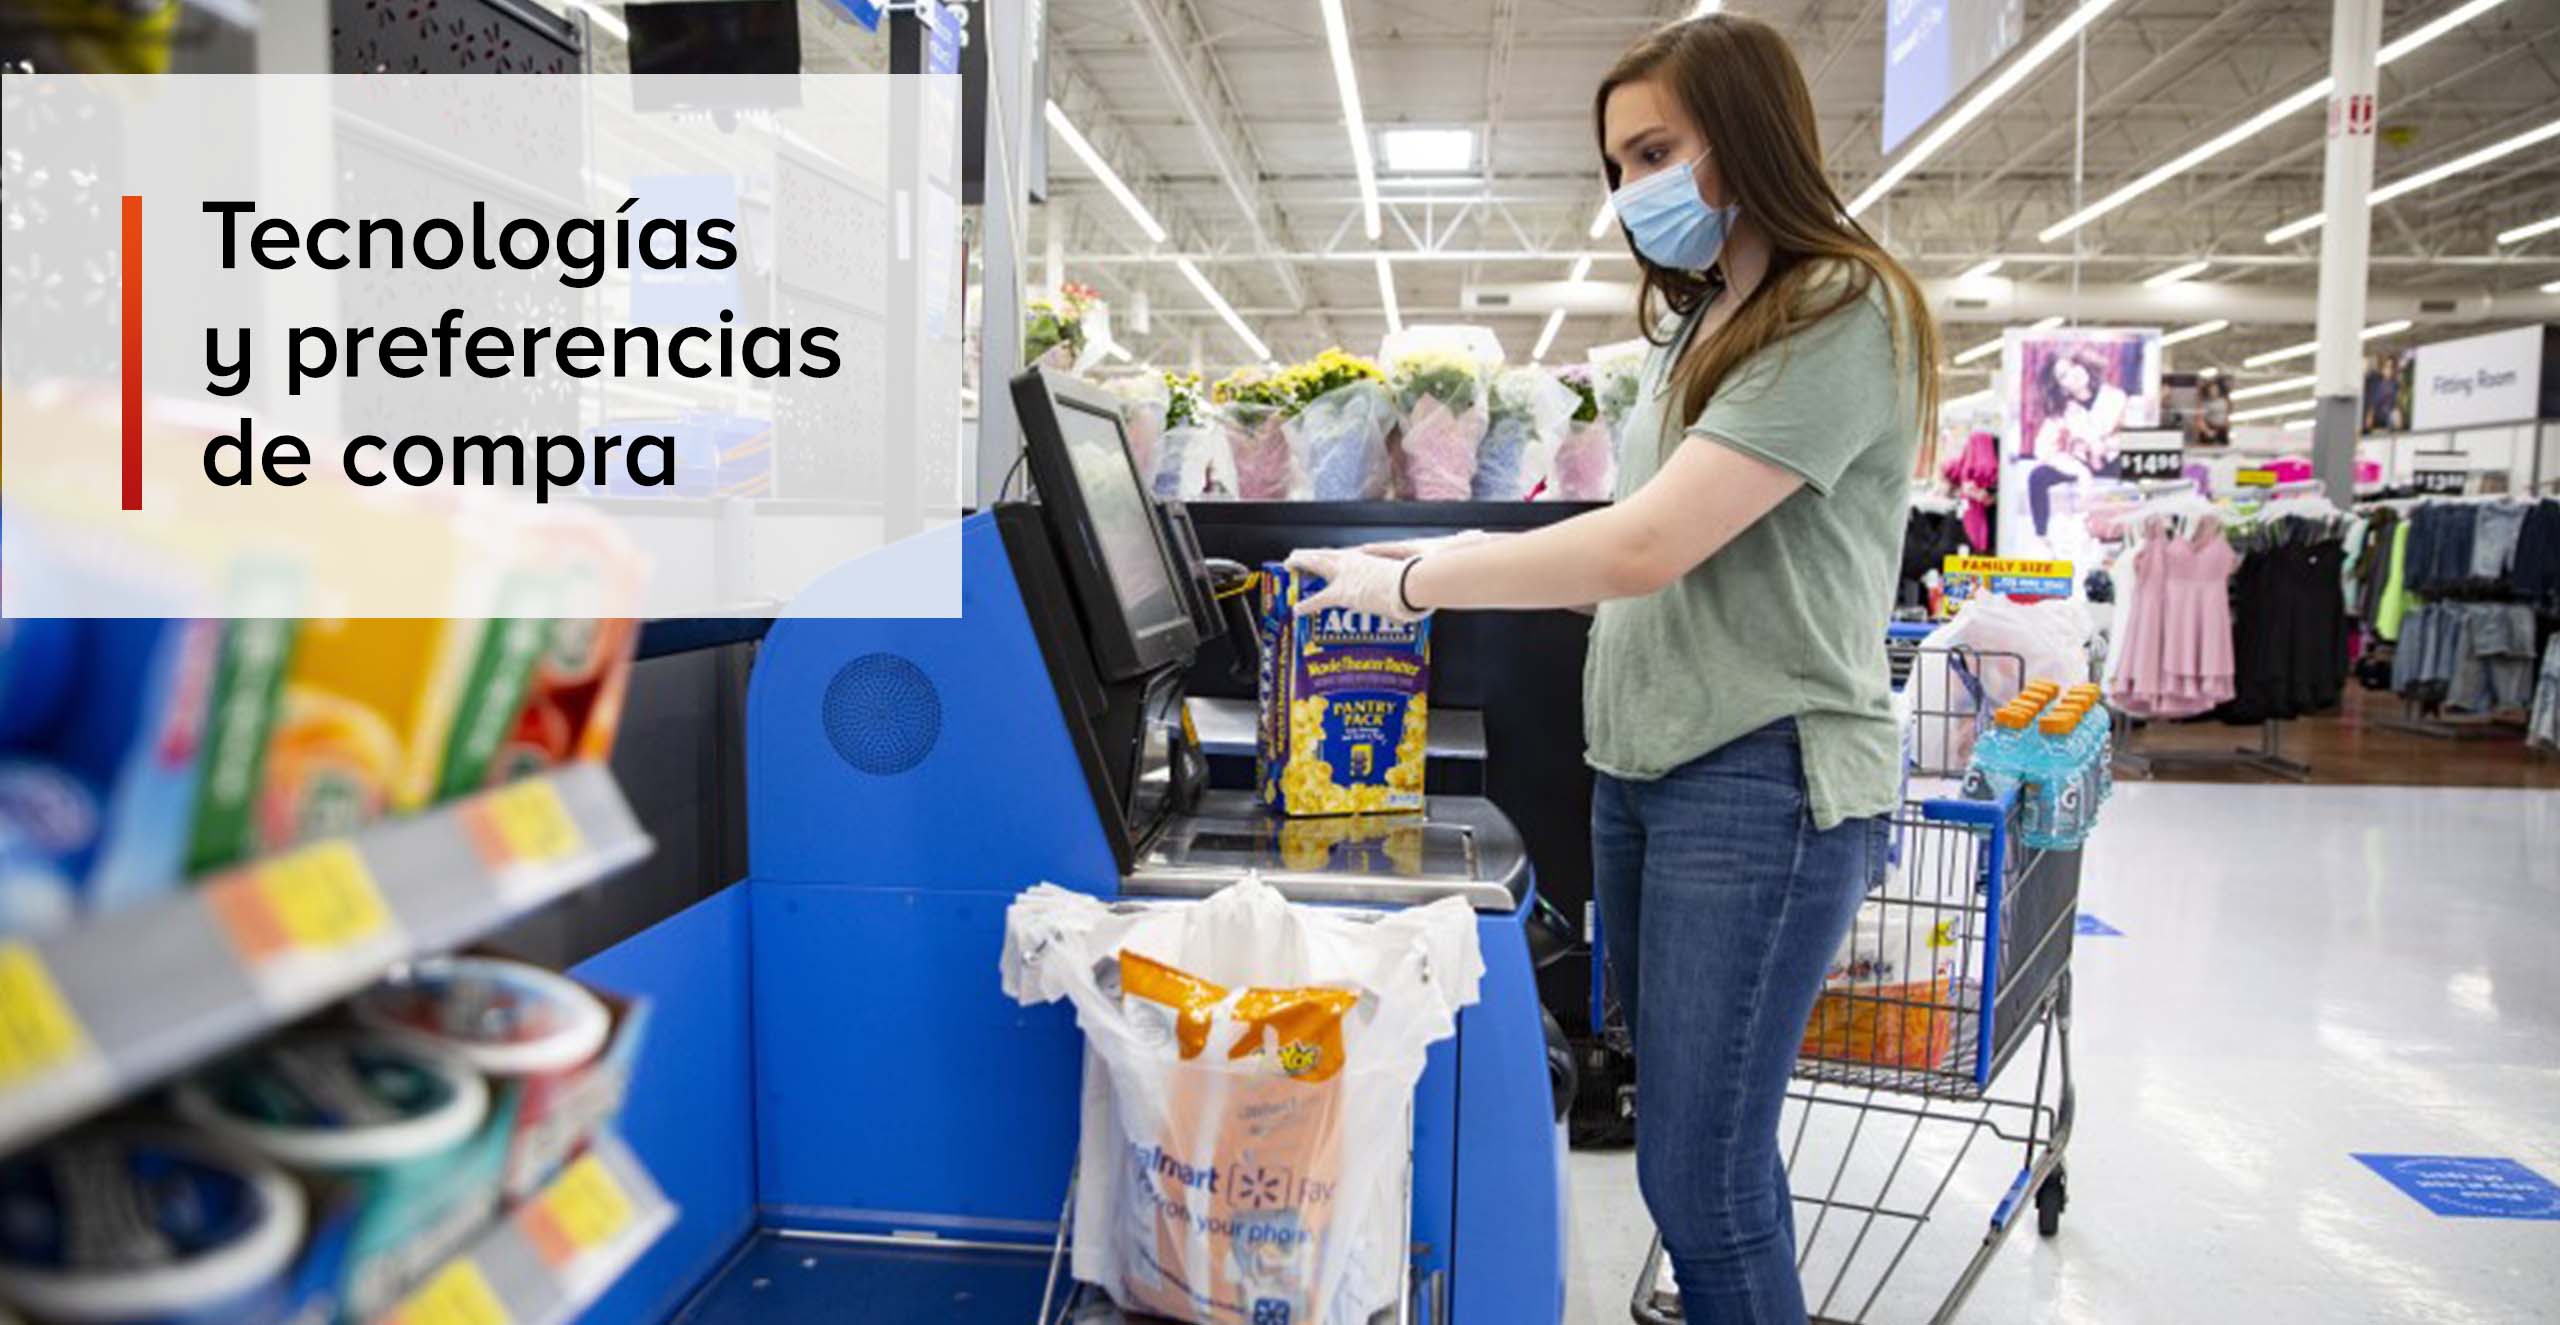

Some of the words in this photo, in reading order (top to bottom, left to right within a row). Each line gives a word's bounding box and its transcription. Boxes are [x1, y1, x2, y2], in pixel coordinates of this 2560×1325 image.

[2433, 373, 2473, 397] Fitting
[2477, 369, 2517, 388] Room
[1961, 560, 2015, 573] FAMILY
[2020, 561, 2054, 573] SIZE
[1334, 701, 1396, 716] PANTRY
[1344, 714, 1384, 726] PACK
[1196, 1214, 1243, 1237] your
